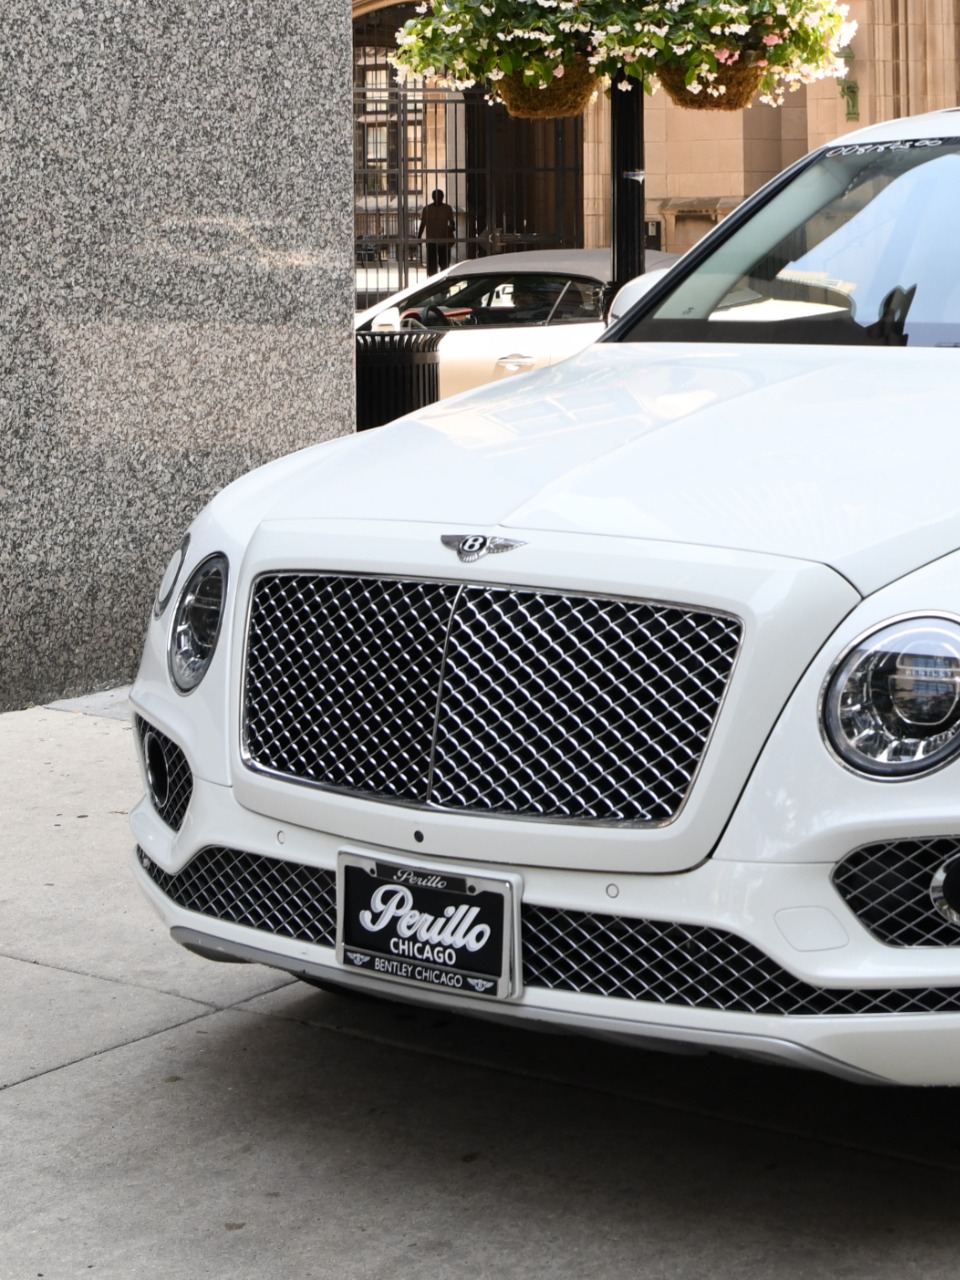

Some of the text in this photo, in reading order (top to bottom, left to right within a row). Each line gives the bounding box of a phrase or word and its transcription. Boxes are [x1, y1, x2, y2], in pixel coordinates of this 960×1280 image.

[392, 869, 448, 889] Perillo
[359, 884, 491, 952] Perillo
[389, 937, 457, 965] CHICAGO
[374, 957, 463, 988] BENTLEY CHICAGO
